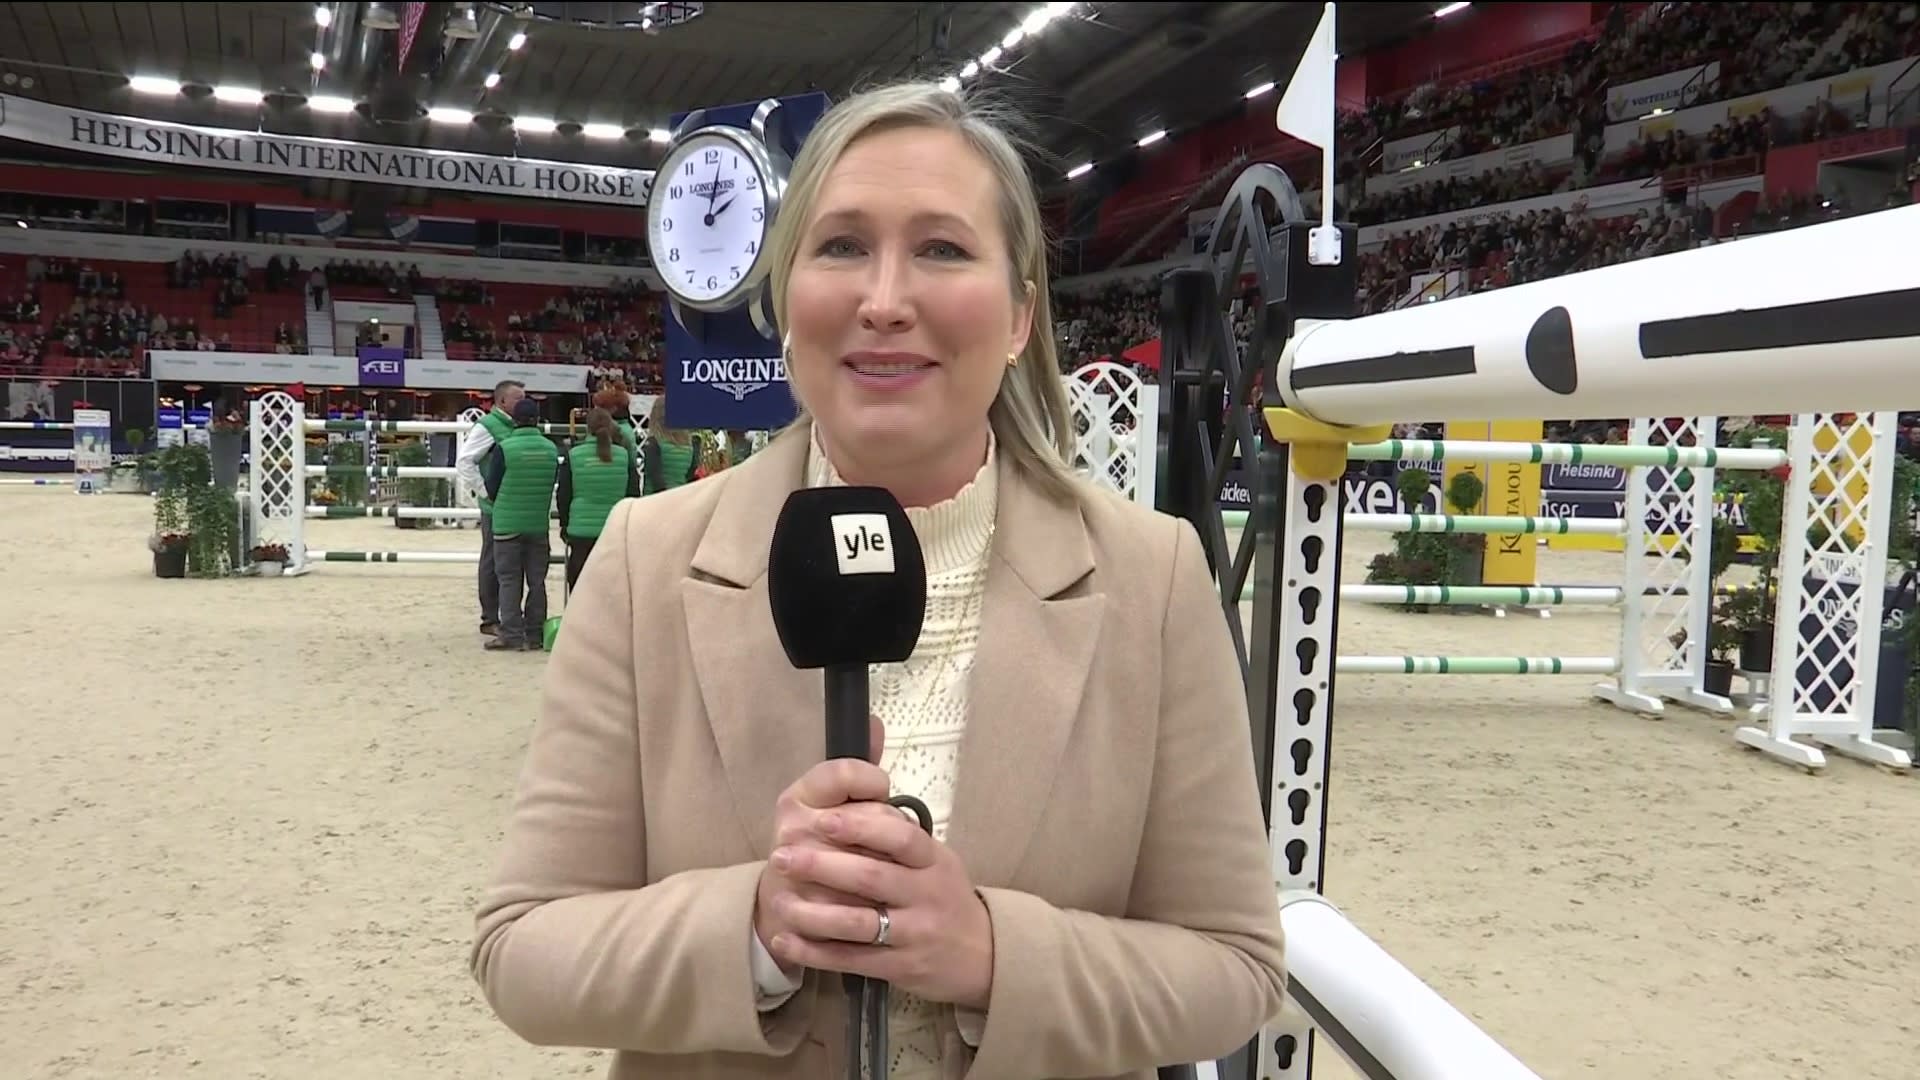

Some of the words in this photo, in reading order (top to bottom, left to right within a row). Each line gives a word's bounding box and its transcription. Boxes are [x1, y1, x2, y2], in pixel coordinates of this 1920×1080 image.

[70, 115, 243, 162] HELSINKI
[255, 139, 525, 188] INTERNATIONAL
[534, 167, 635, 198] HORSE
[704, 149, 719, 165] 12
[685, 162, 695, 176] 11
[689, 179, 735, 194] LONGNES
[746, 175, 757, 191] 2
[670, 185, 683, 200] 10
[752, 206, 764, 223] 3
[663, 217, 673, 232] 9
[669, 247, 680, 262] 8
[744, 240, 756, 255] 4
[685, 269, 696, 284] 7
[729, 265, 740, 281] 5
[707, 275, 718, 291] 6
[681, 358, 788, 382] LONGINE
[1559, 463, 1617, 478] Helsinki
[844, 525, 885, 559] yle
